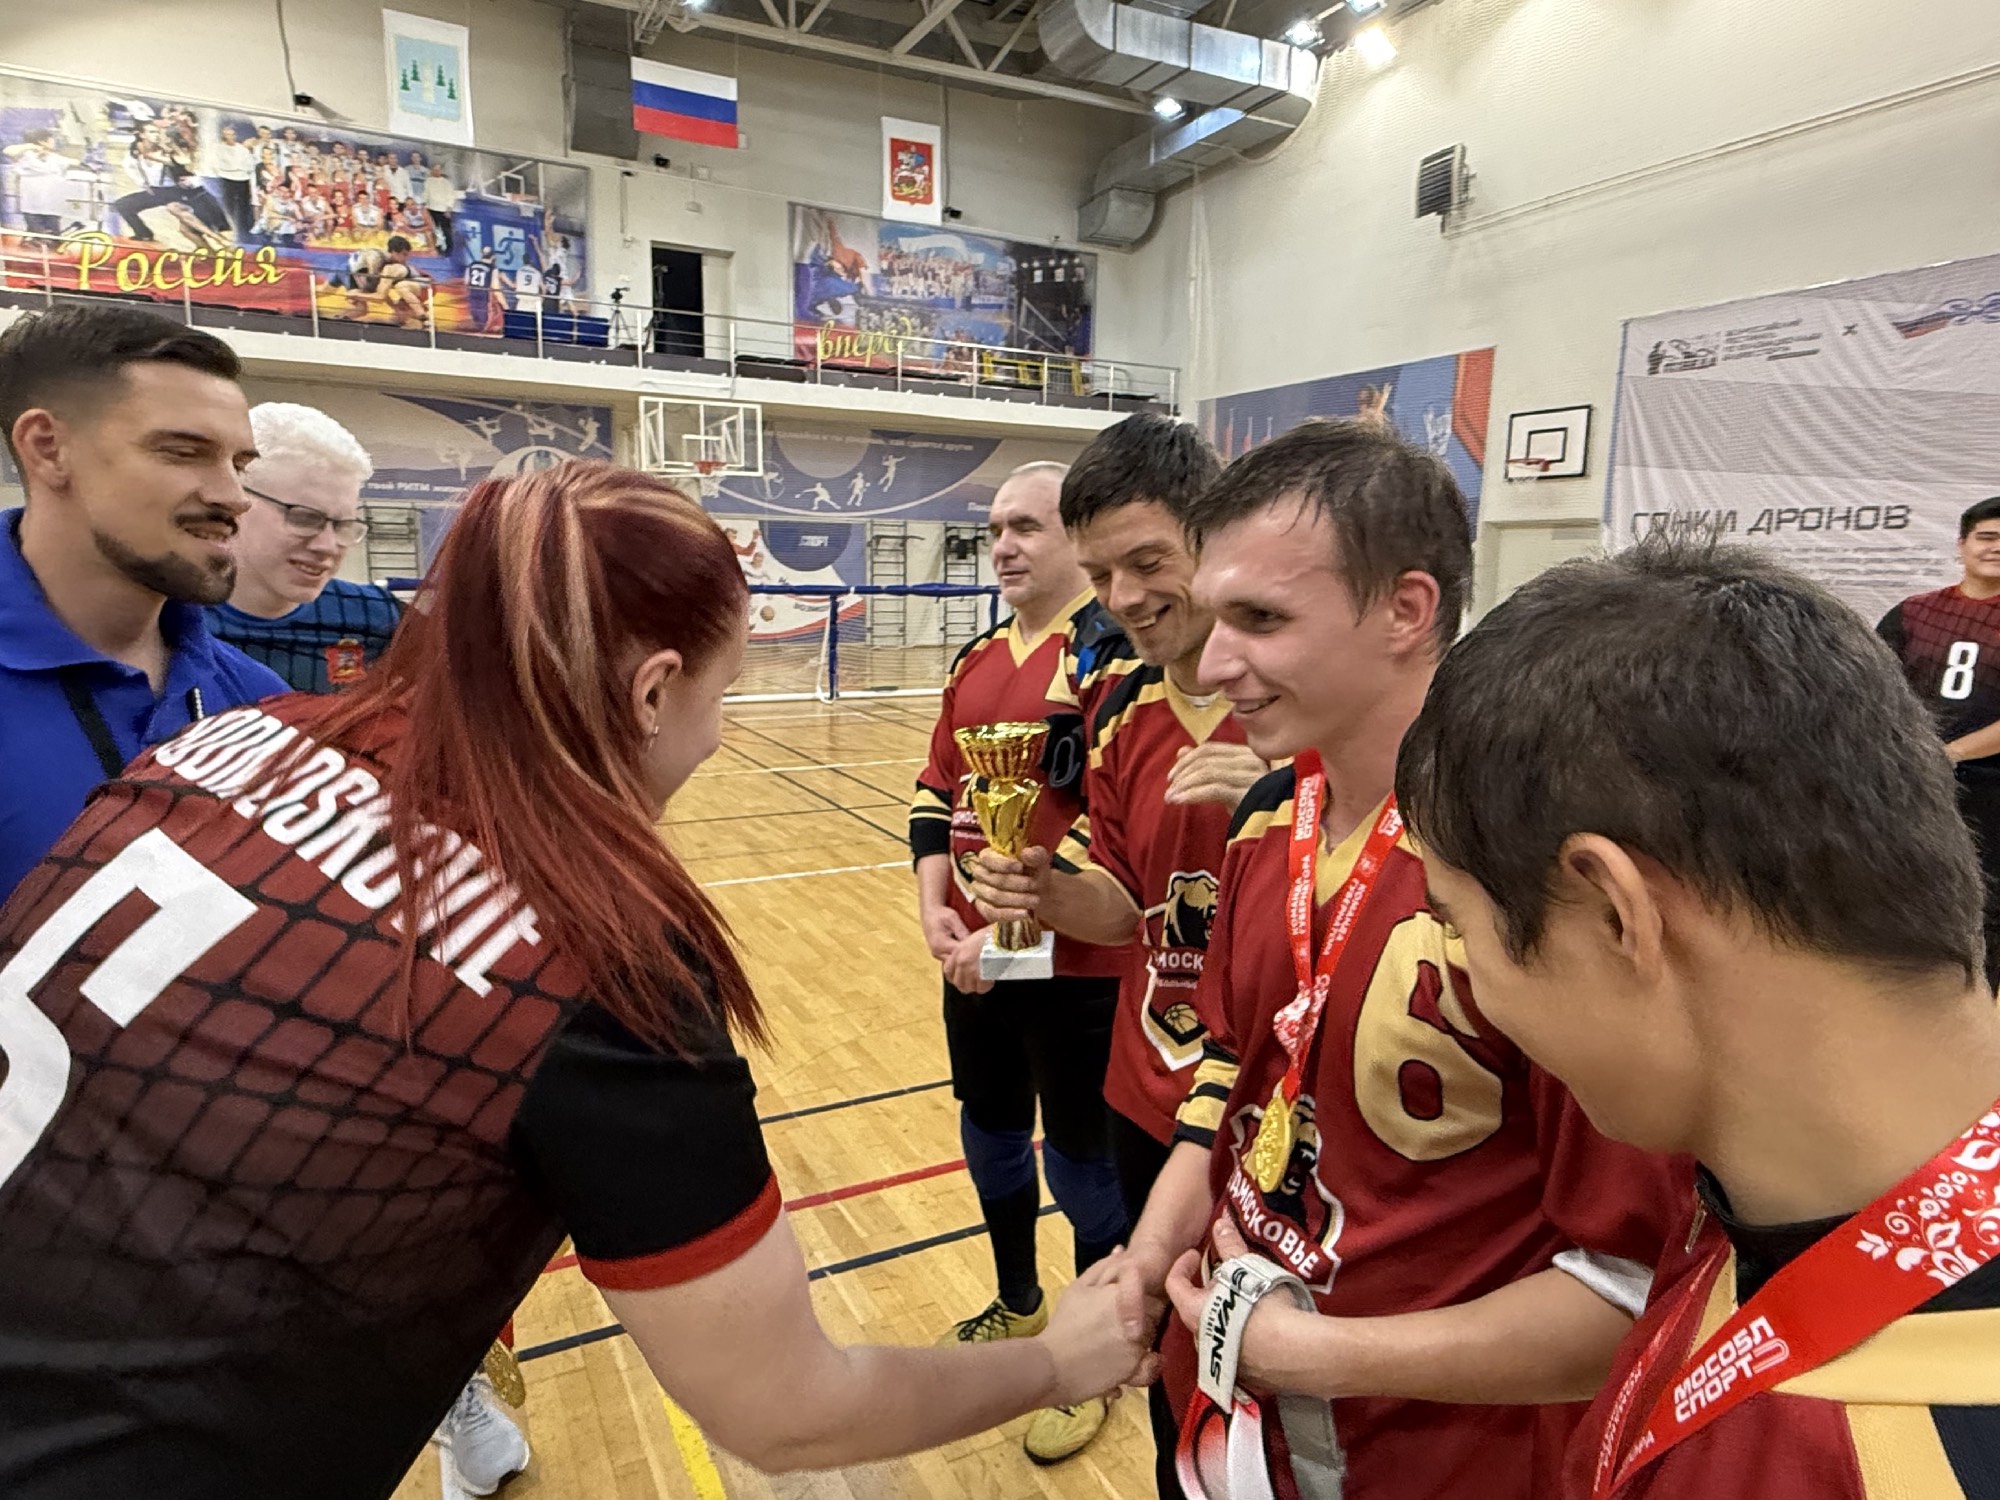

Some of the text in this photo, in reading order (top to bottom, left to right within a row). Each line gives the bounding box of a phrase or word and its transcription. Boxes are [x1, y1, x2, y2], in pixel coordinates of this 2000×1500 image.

[57, 231, 288, 292] Россия
[1746, 504, 1912, 535] ДРОНОВ
[1940, 641, 1980, 700] 8
[1353, 910, 1504, 1162] 6
[1673, 1314, 1776, 1405] МОСОБЛ
[1674, 1354, 1755, 1424] СПОРТ
